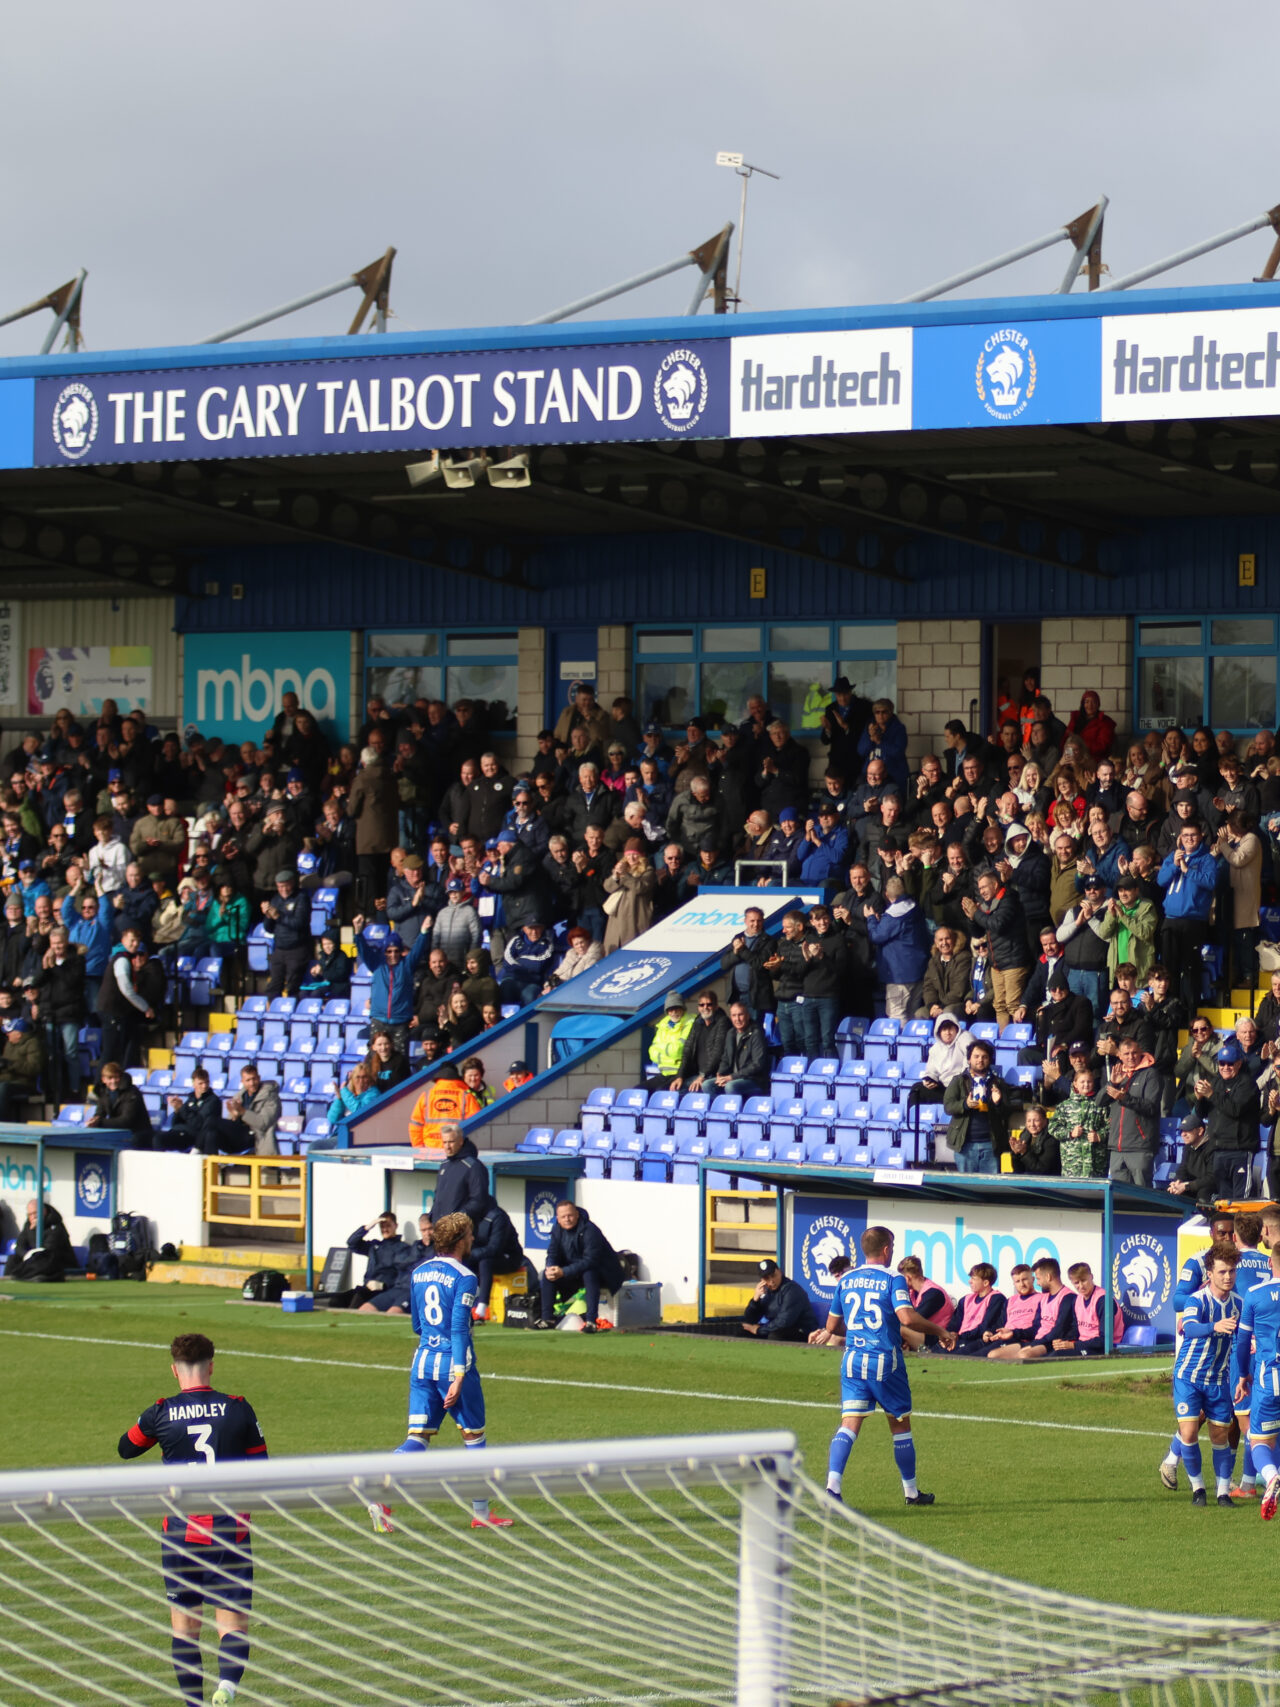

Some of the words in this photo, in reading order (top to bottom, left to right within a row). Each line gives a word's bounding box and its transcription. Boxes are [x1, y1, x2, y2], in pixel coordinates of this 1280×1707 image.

[984, 328, 1029, 352] CHESTER
[661, 349, 701, 371] CHESTER
[741, 352, 900, 412] Hardtech
[108, 389, 186, 444] THE
[196, 382, 308, 441] GARY
[317, 373, 481, 434] TALBOT
[492, 364, 643, 427] STAND
[983, 402, 1012, 420] FOOTBALL
[1013, 400, 1028, 417] CLUB
[1243, 560, 1252, 580] E
[753, 574, 762, 593] E
[197, 654, 336, 722] mbna
[1140, 719, 1153, 729] THE
[809, 1215, 850, 1237] CHESTER
[1120, 1233, 1164, 1256] CHESTER
[841, 1277, 888, 1291] K.ROBERTS
[424, 1284, 443, 1326] 8
[844, 1291, 883, 1331] 25
[1120, 1302, 1147, 1321] FOOTBALL
[1147, 1304, 1162, 1320] CLUB
[169, 1402, 227, 1421] HANDLEY
[187, 1423, 216, 1466] 3
